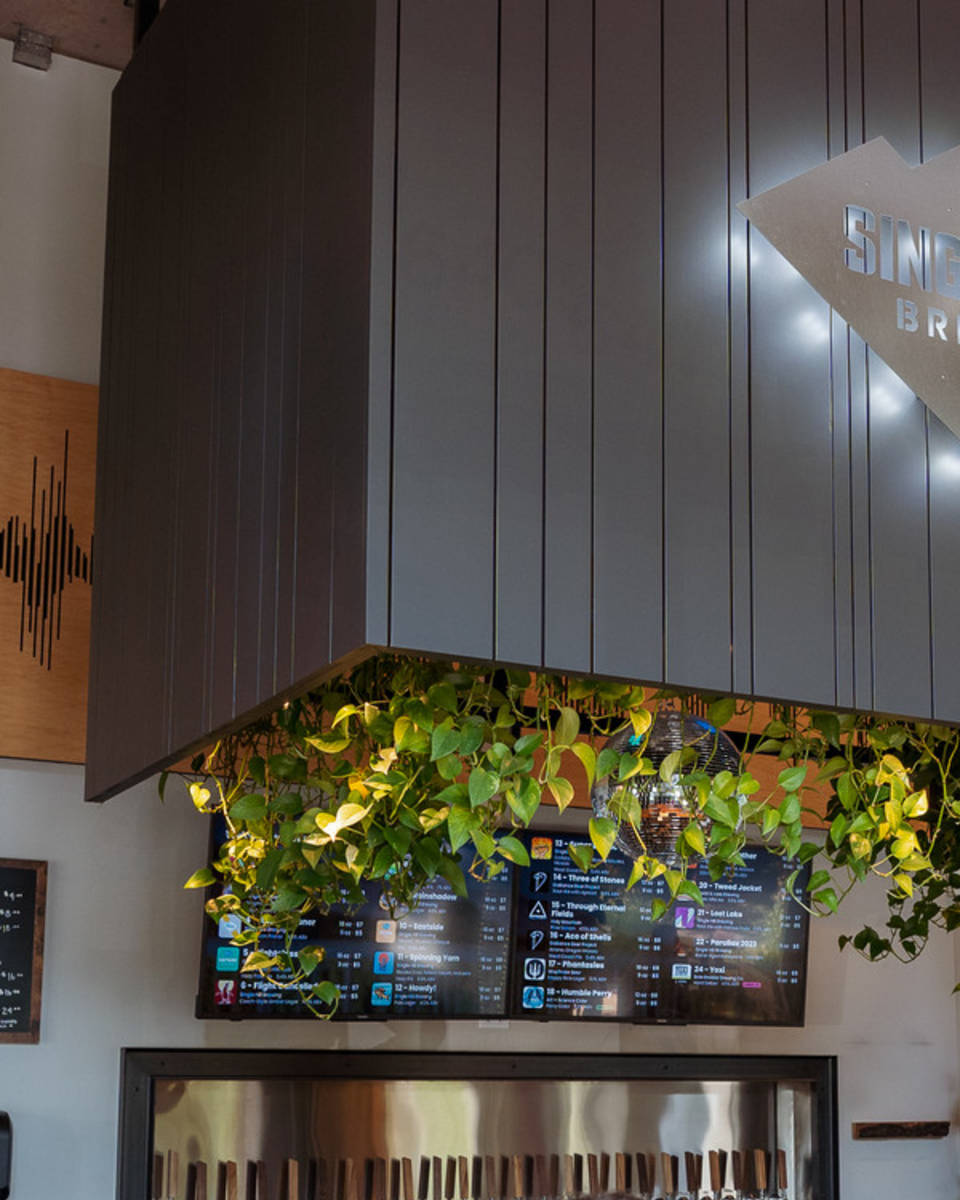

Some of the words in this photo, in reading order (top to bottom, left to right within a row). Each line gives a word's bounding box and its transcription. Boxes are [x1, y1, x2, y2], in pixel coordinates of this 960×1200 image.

[552, 873, 562, 881] 14
[568, 874, 589, 882] Three
[600, 876, 625, 884] Stones
[738, 884, 763, 892] Jacket
[567, 902, 599, 912] Through
[600, 903, 626, 912] Eternal
[552, 910, 574, 918] Fields
[726, 910, 743, 918] Lake
[561, 988, 591, 997] Humble
[592, 990, 612, 998] Perry
